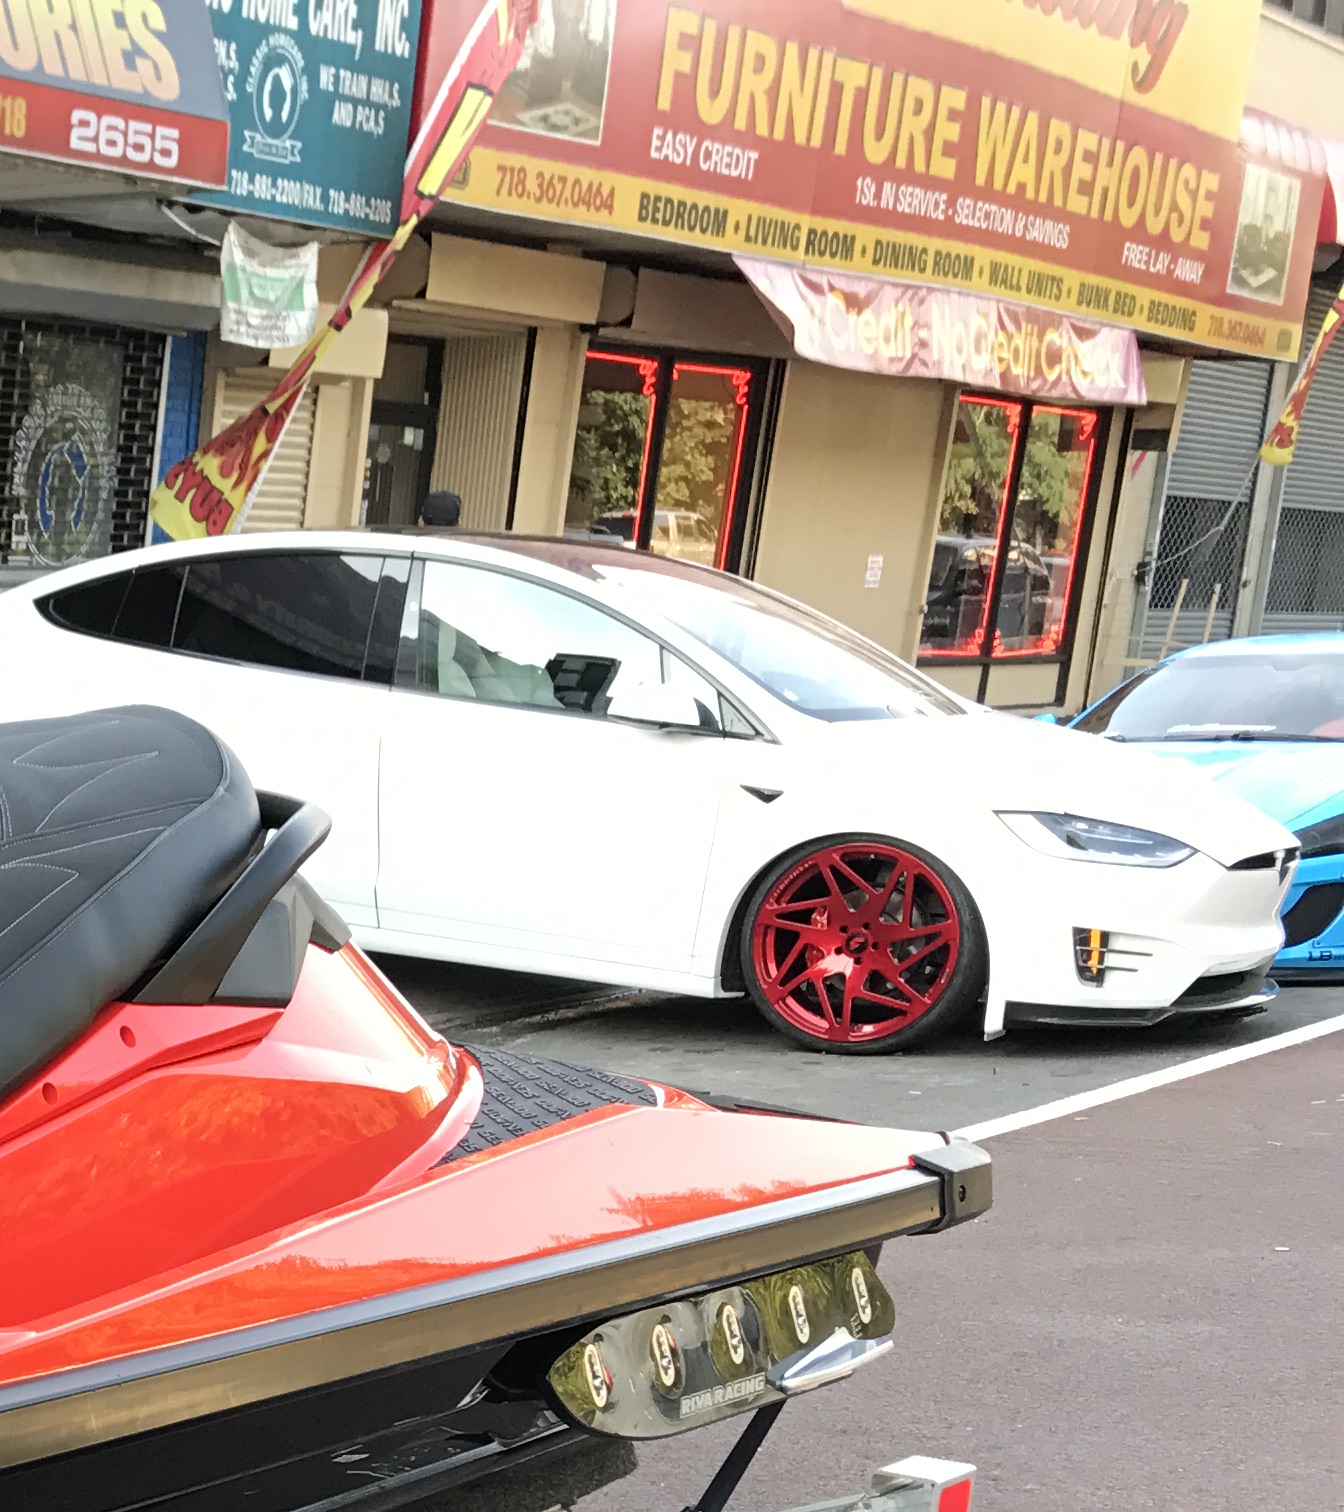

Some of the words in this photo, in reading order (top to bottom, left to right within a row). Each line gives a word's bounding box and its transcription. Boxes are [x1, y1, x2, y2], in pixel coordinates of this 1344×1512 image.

[320, 63, 336, 92] WE
[339, 69, 368, 100] TRAIN
[69, 109, 180, 168] 2655
[332, 100, 354, 128] AND
[657, 6, 967, 181] FURNITURE
[974, 93, 1222, 253] WAREHOUSE
[649, 126, 698, 166] EASY
[699, 141, 759, 181] CREDIT
[496, 164, 616, 217] 718.367.0464
[879, 182, 896, 209] IN
[897, 185, 949, 221] SERVICE
[954, 198, 1014, 238] SELECTION
[1014, 214, 1025, 239] &
[1025, 218, 1071, 250] SAVINGS
[637, 191, 728, 238] BEDROOM
[744, 213, 802, 252] LIVING
[803, 228, 857, 262] ROOM
[871, 239, 928, 274] DINING
[931, 249, 976, 282] ROOM
[987, 260, 1023, 293] WALL
[1025, 267, 1064, 302] UNITS
[1075, 281, 1111, 313] BUNK
[1112, 288, 1137, 319] BED
[1146, 300, 1198, 333] BEDDING
[1121, 242, 1149, 270] FREE
[824, 290, 914, 358] Credit
[680, 1387, 712, 1419] RIVA
[711, 1372, 766, 1405] RACING
